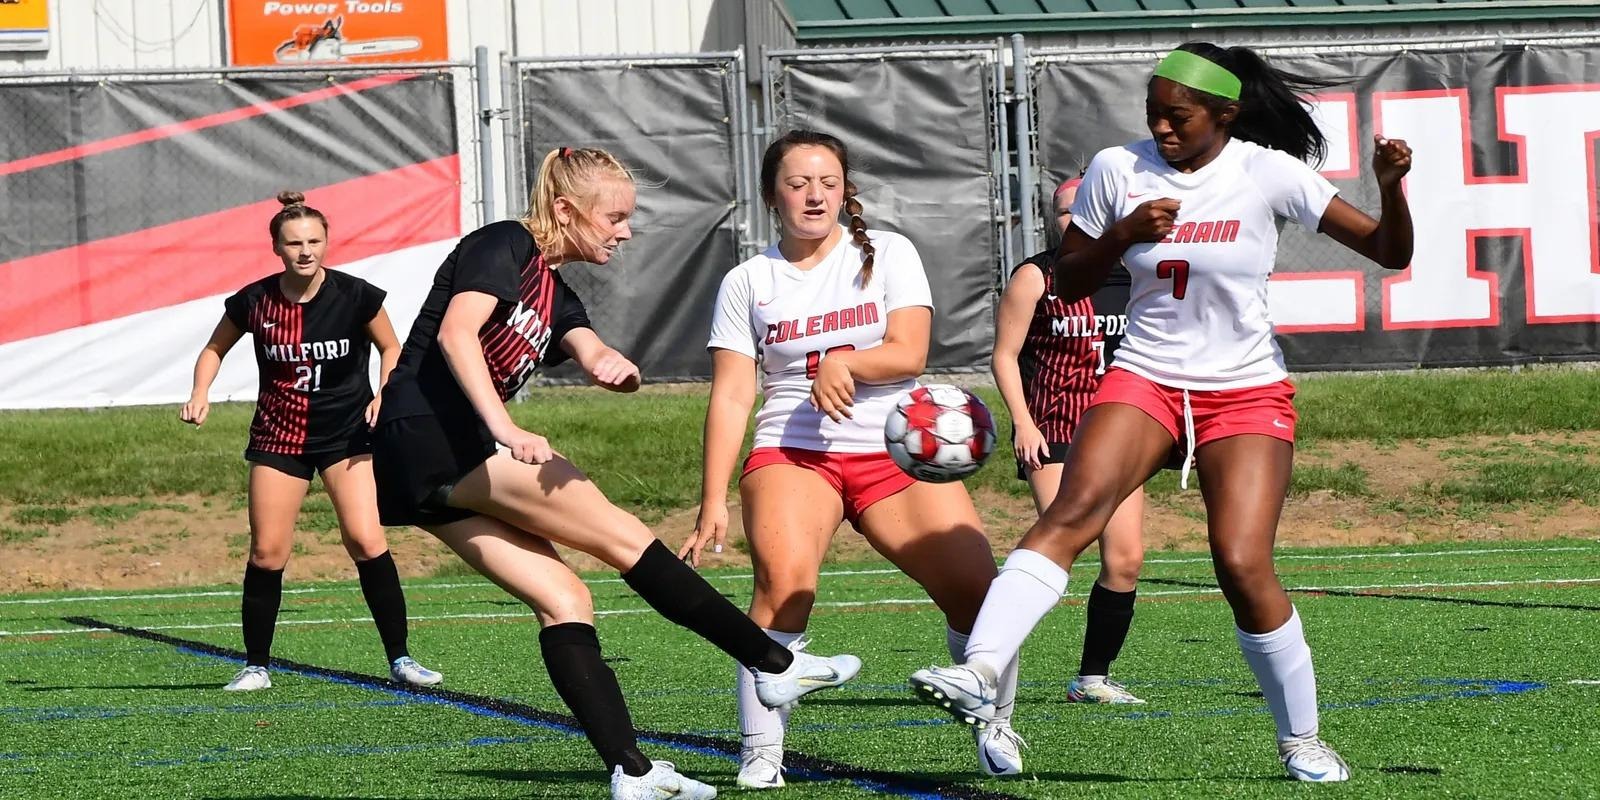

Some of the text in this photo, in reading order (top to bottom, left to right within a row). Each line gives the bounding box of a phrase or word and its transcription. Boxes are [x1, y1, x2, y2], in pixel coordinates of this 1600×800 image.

[264, 0, 403, 15] Power Tools
[1156, 259, 1190, 300] 7
[765, 302, 879, 345] COLERAIN
[1051, 314, 1129, 338] MILFOR
[263, 339, 350, 362] MILFORD
[805, 344, 855, 380] 1
[1091, 340, 1106, 375] 7
[293, 364, 322, 392] 21
